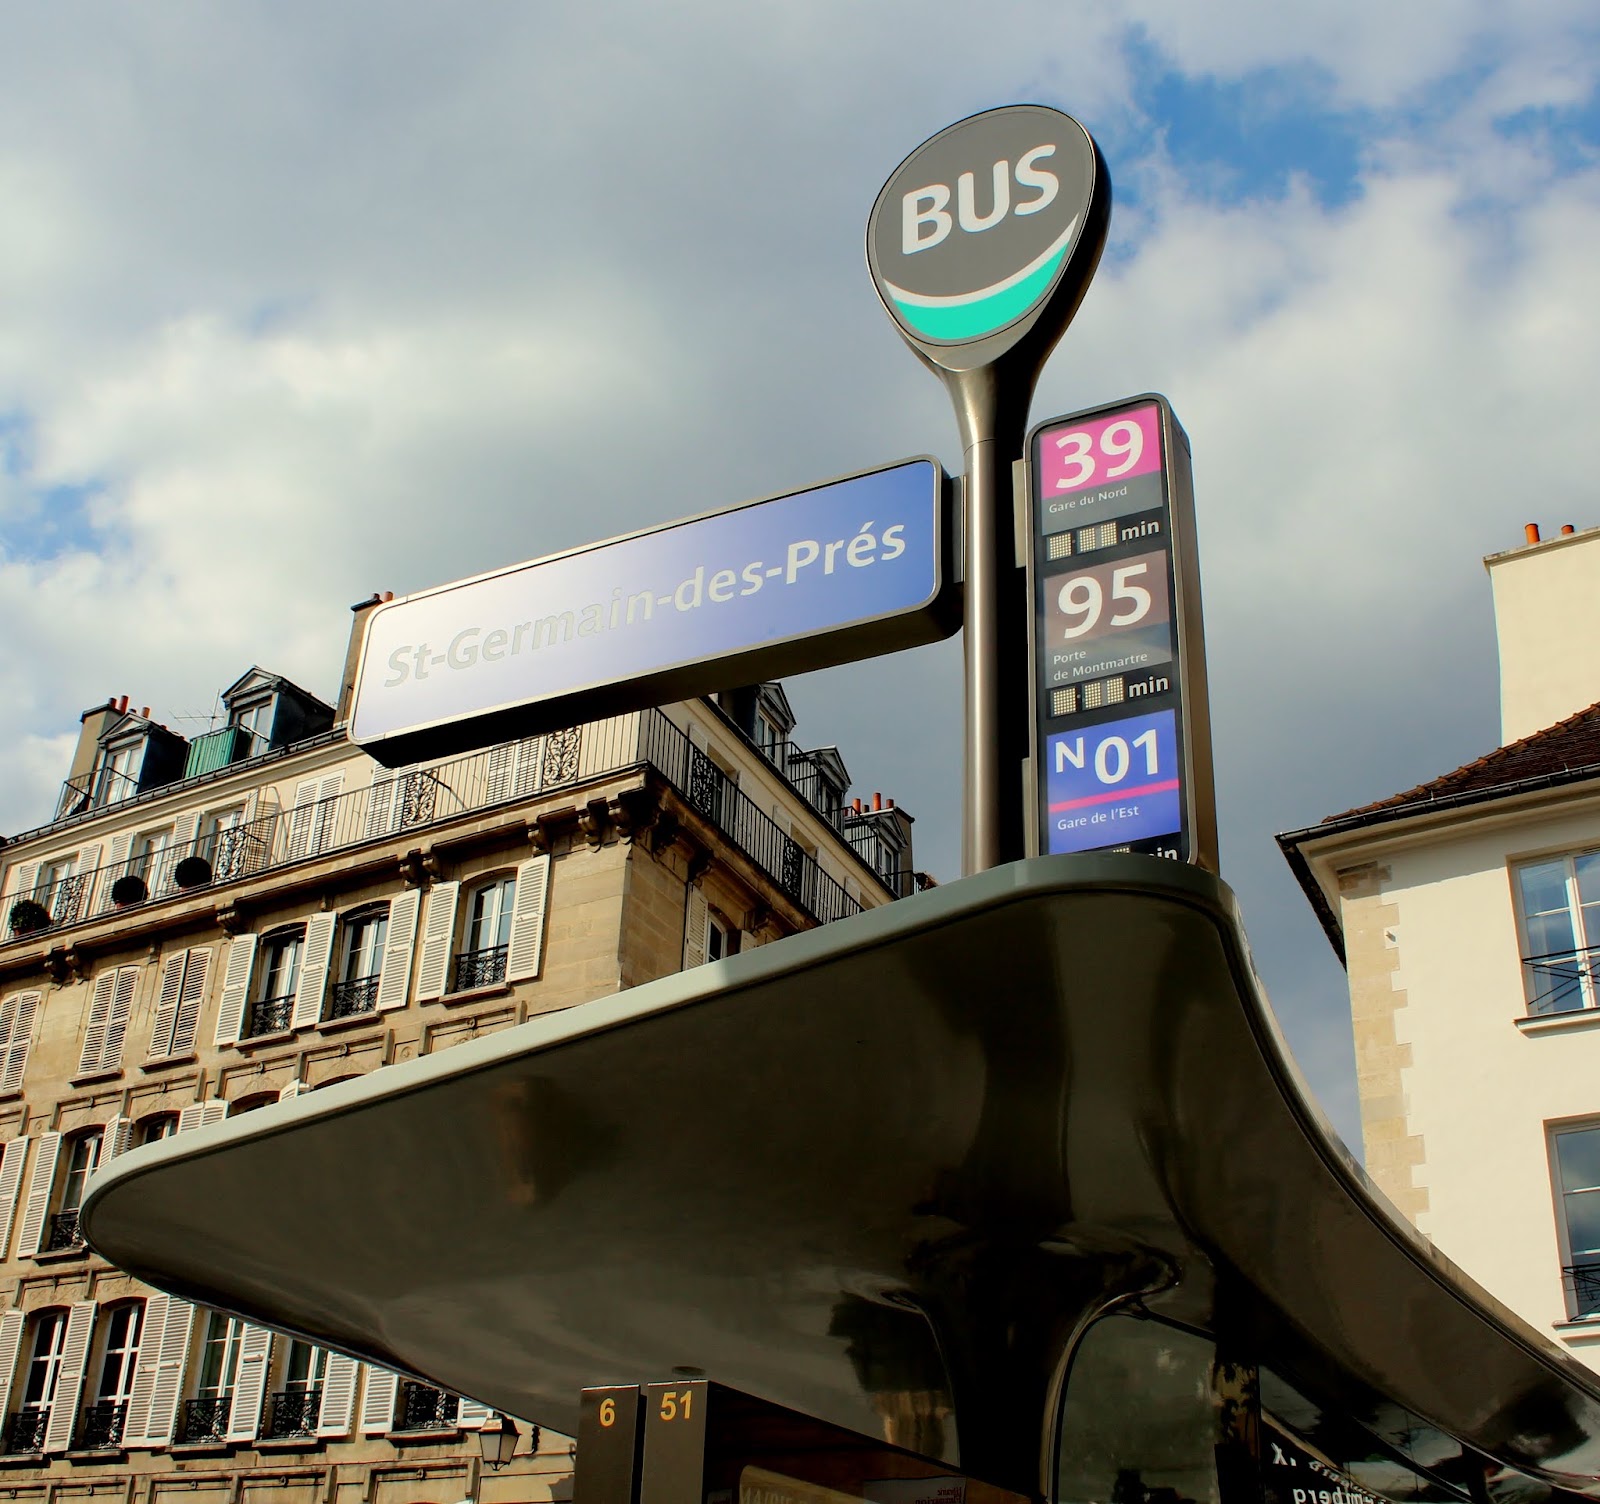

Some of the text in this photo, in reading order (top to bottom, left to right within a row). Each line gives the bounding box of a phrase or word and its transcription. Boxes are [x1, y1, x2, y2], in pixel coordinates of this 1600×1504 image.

[902, 144, 1060, 255] BUS
[1055, 420, 1144, 489] 39
[1048, 486, 1128, 514] Gare du Nord
[1121, 520, 1160, 541] min
[384, 520, 906, 688] St-Germain-des-Prés
[1058, 563, 1151, 639] 95
[1053, 650, 1087, 665] Porte
[1053, 652, 1148, 681] de Montmartre
[1128, 676, 1169, 698] min
[1057, 805, 1140, 831] Gare de l'Est
[1149, 847, 1178, 860] in
[600, 1398, 615, 1427] 6
[660, 1390, 692, 1420] 51
